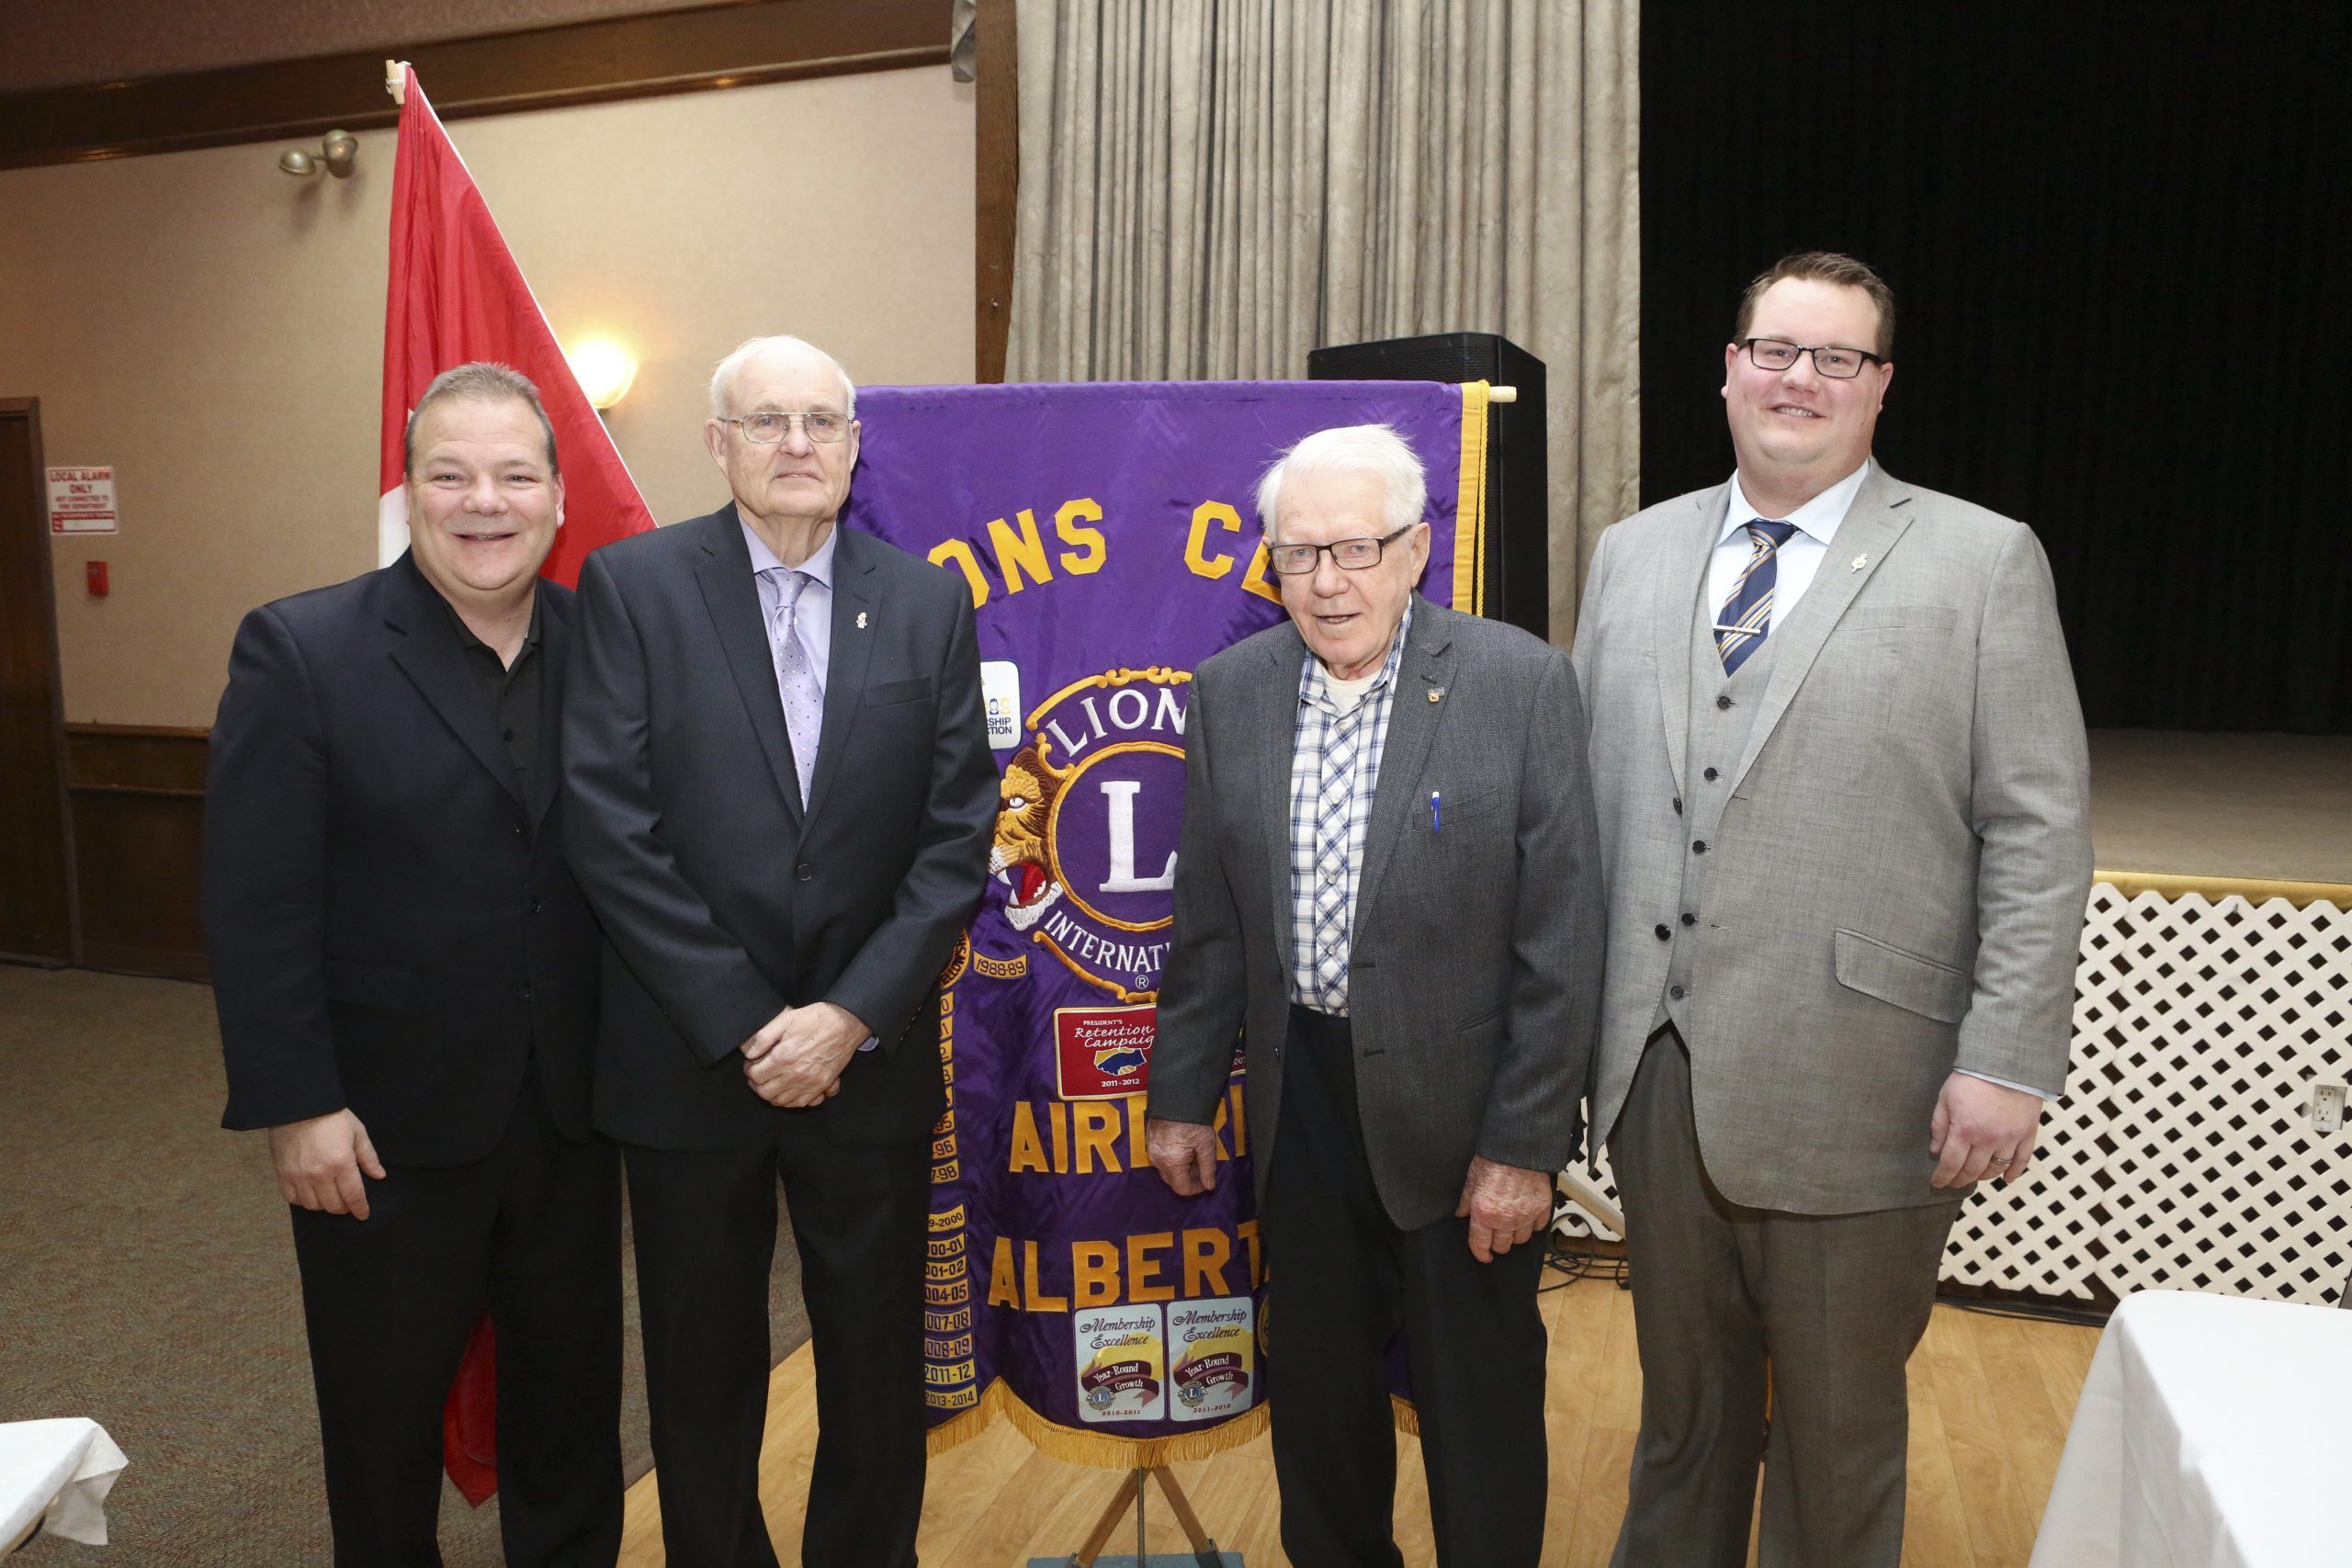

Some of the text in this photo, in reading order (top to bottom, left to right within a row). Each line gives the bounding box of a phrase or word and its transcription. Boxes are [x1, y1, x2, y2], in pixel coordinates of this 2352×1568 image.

[51, 471, 111, 482] LOCAL ALARM
[70, 483, 93, 493] ONLY
[1100, 781, 1177, 892] L
[1044, 910, 1170, 973] INTERNAT
[976, 958, 1025, 976] 1988-89
[1074, 1023, 1155, 1038] Retention
[1101, 1078, 1140, 1088] 2011-2012
[988, 1220, 1270, 1313] ALBERT
[1080, 1316, 1156, 1333] Membership
[1172, 1309, 1247, 1325] Membership
[1091, 1334, 1149, 1349] Excellence
[1183, 1326, 1240, 1342] Excellence
[1114, 1379, 1144, 1391] Growth
[1205, 1371, 1234, 1385] Growth
